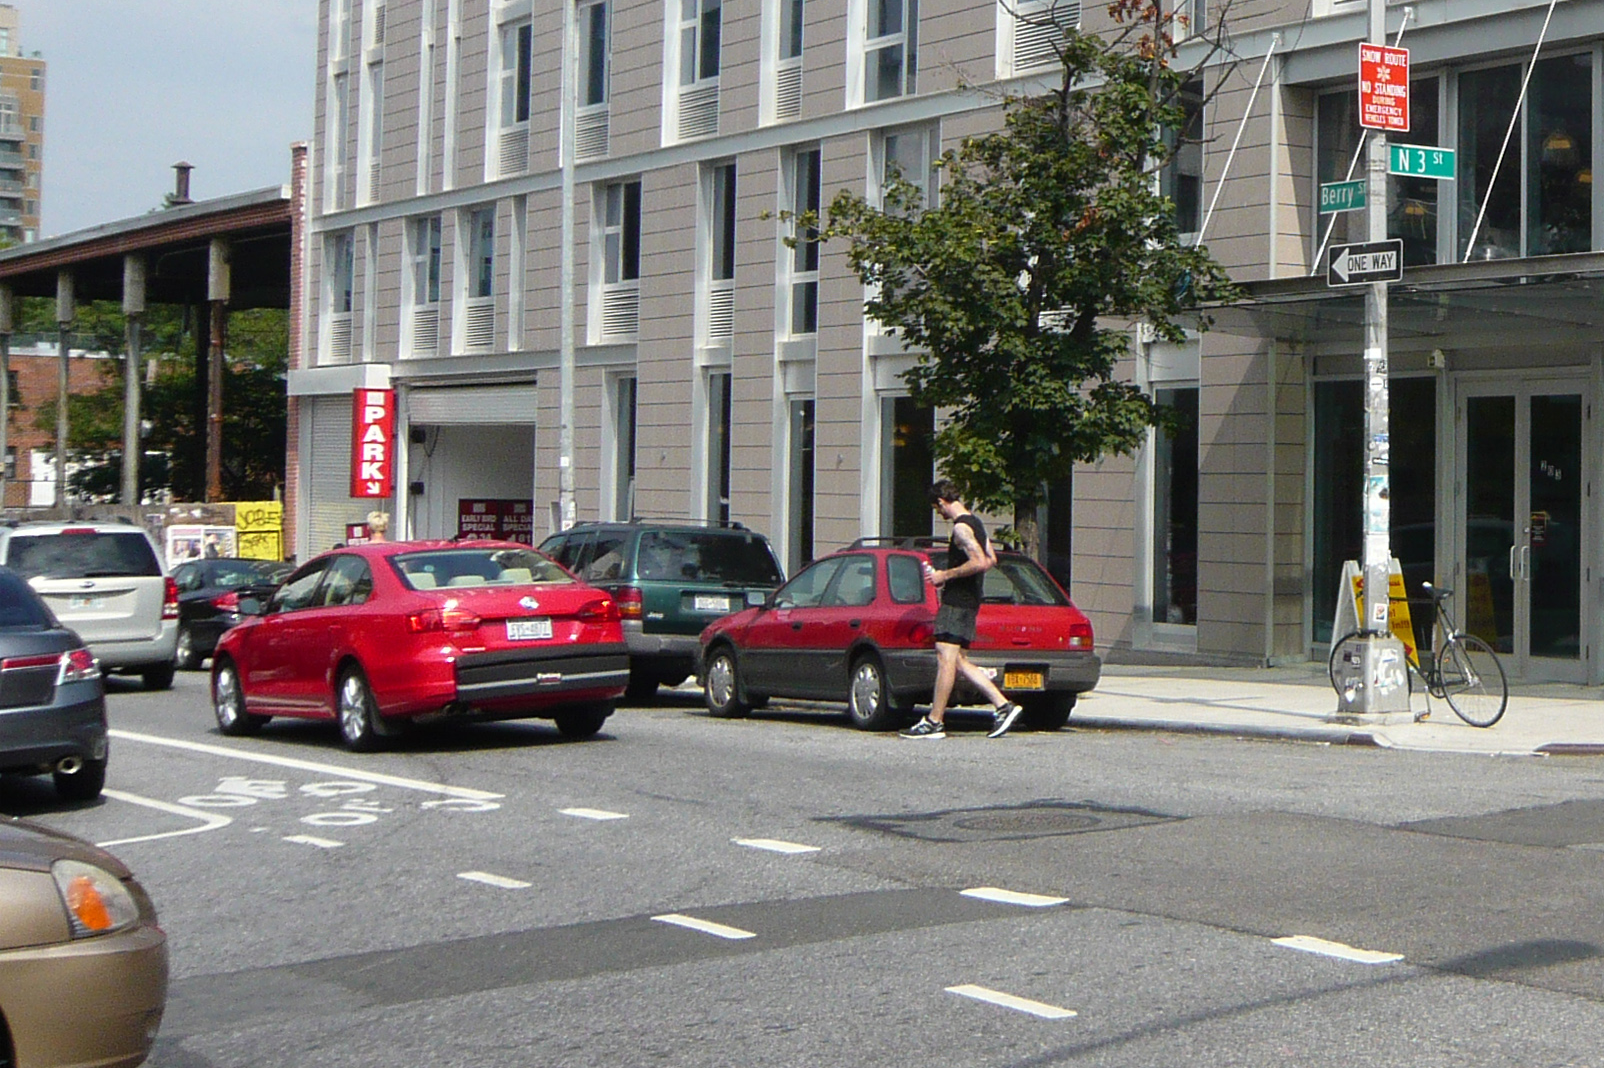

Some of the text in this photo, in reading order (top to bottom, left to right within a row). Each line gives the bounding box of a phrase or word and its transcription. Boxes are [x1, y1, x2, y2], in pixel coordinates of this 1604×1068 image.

[1362, 49, 1406, 67] SNOW ROUTE
[1361, 80, 1406, 98] NO STANDING
[1399, 149, 1443, 173] N 3 St
[1321, 187, 1354, 207] Berry
[1347, 252, 1394, 271] ONE WAY
[362, 406, 386, 480] PARK
[462, 523, 495, 532] SPECIAL
[502, 523, 533, 531] SPECIA
[503, 515, 533, 523] ALL DA
